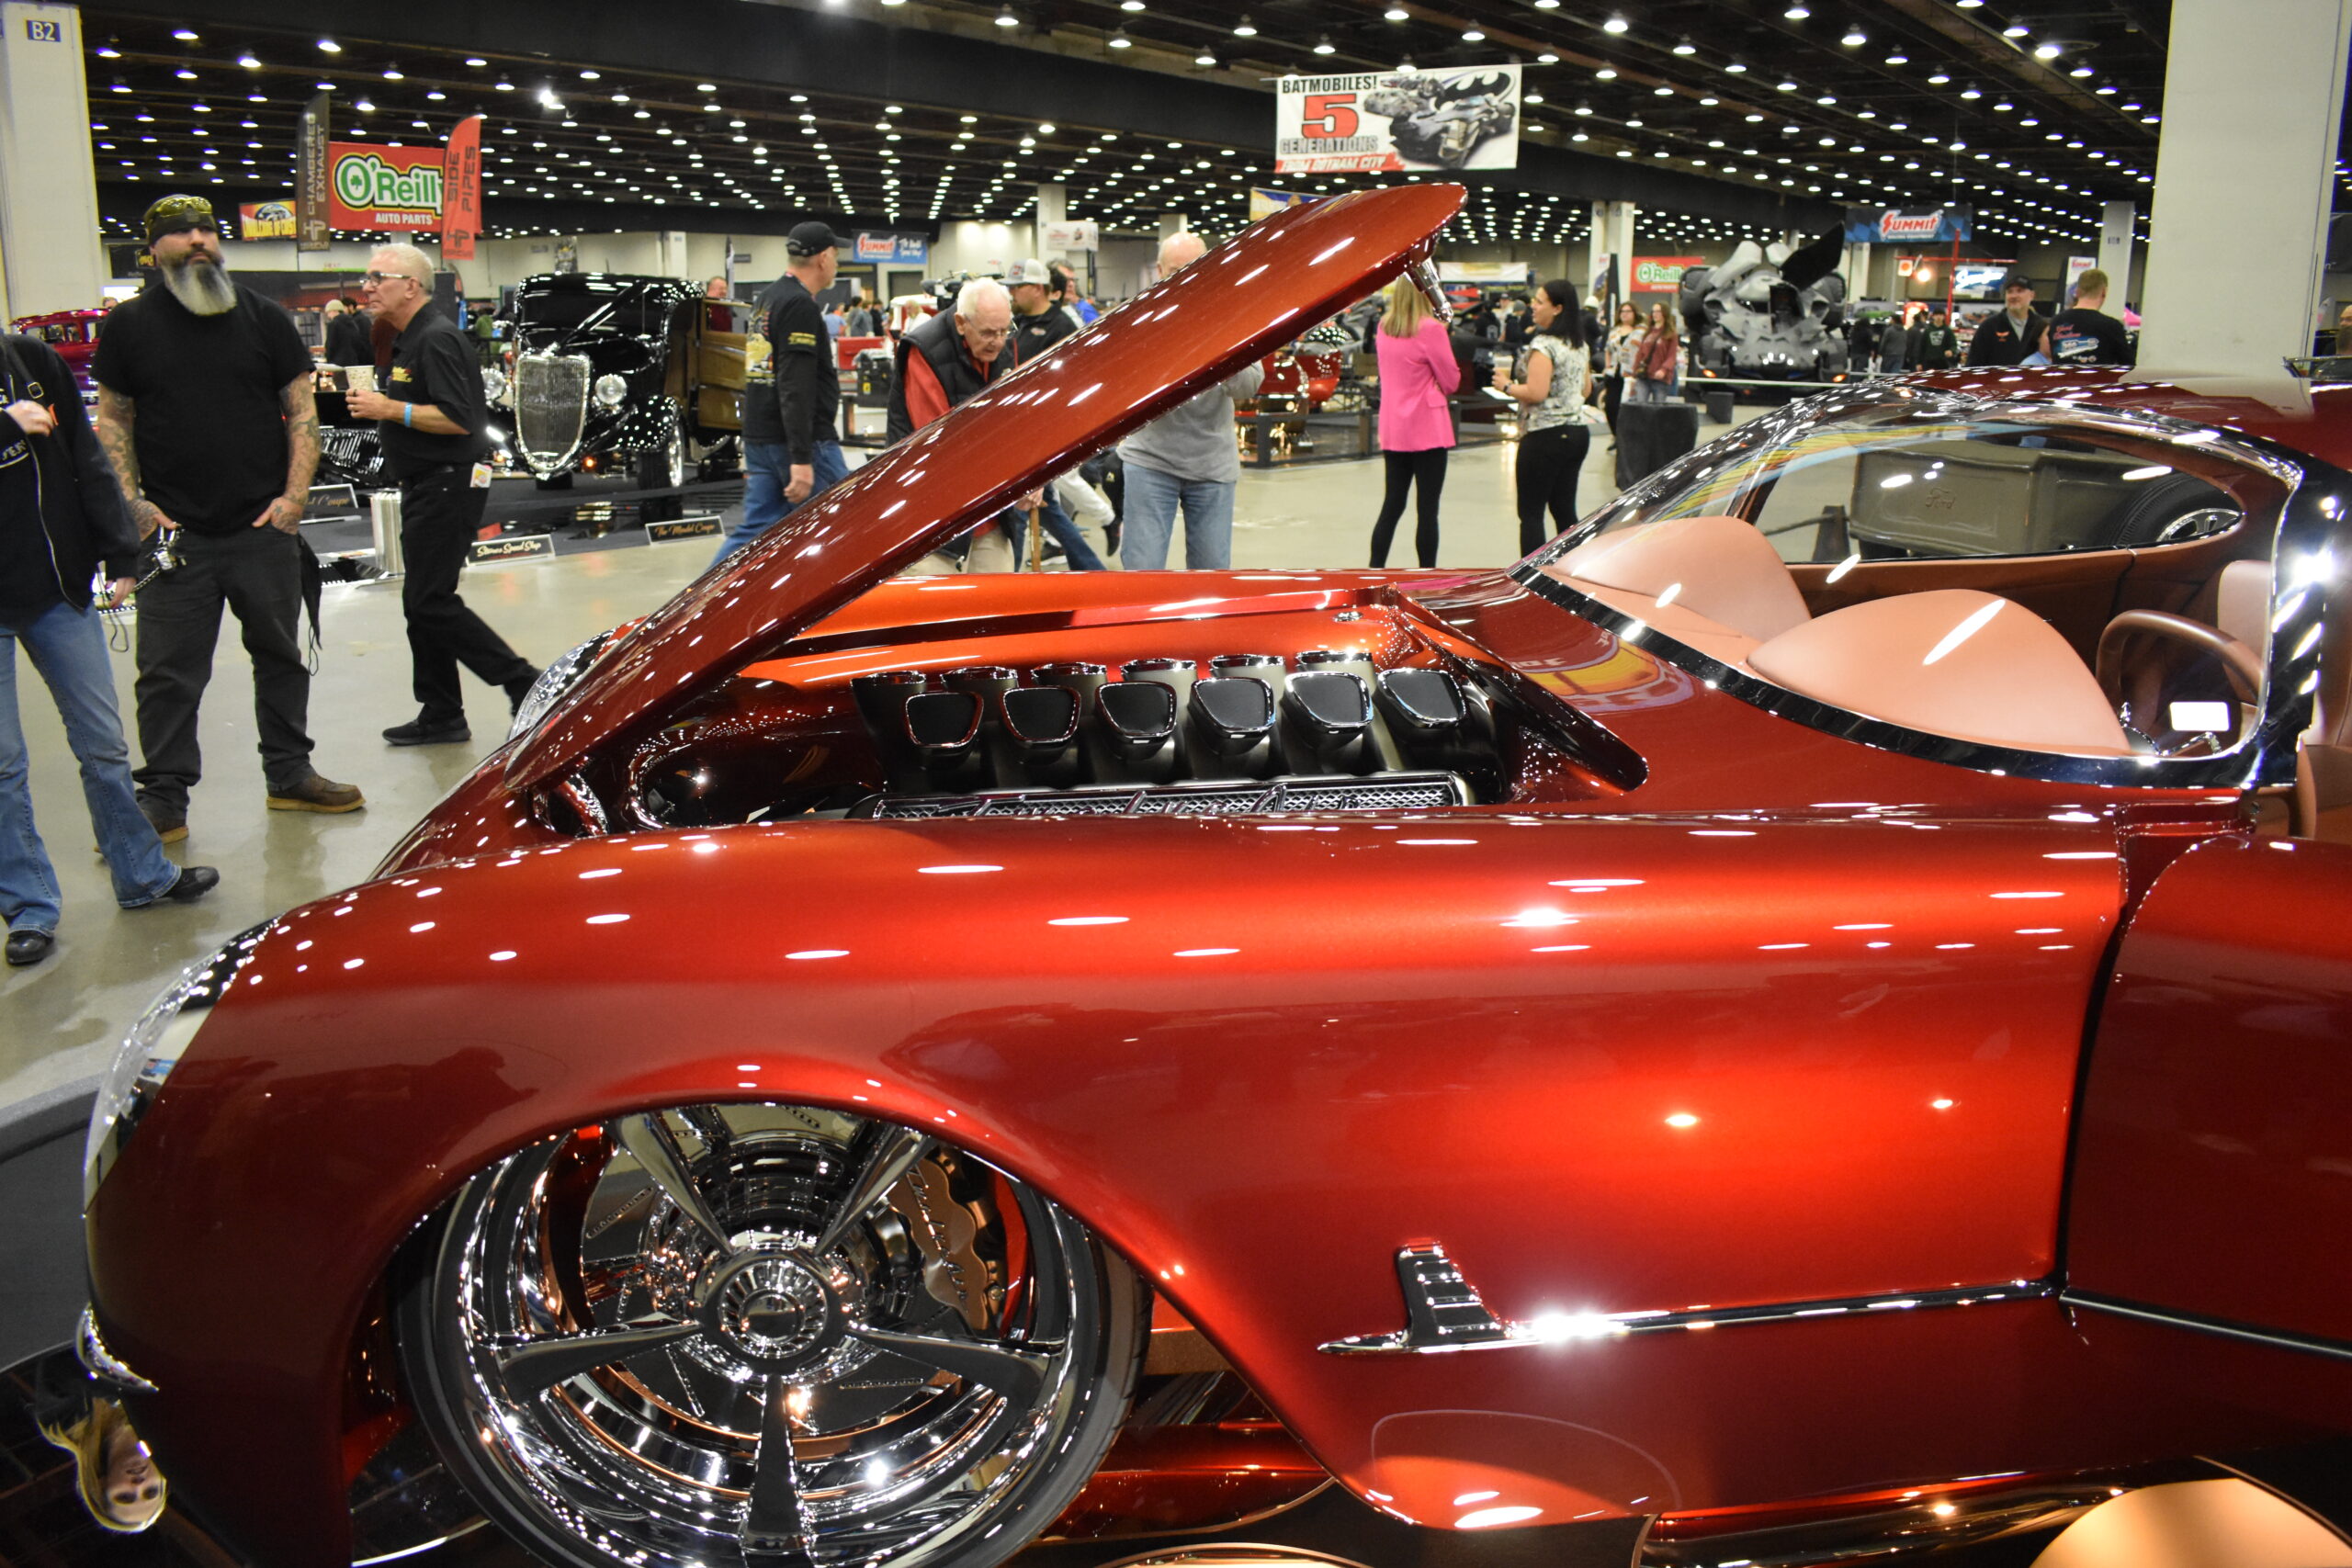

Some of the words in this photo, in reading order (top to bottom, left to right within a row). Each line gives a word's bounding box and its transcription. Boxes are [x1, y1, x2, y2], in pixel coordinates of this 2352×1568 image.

[31, 21, 56, 41] B2
[1282, 75, 1378, 94] BATMOBILES!
[1301, 93, 1360, 139] 5
[1280, 135, 1379, 154] GENERATIONS
[315, 125, 325, 202] EXHAUST
[1360, 155, 1387, 169] CITY
[447, 152, 459, 202] SIDE
[461, 145, 477, 213] PIPES
[376, 213, 401, 224] AUTO
[401, 214, 433, 225] PARTS
